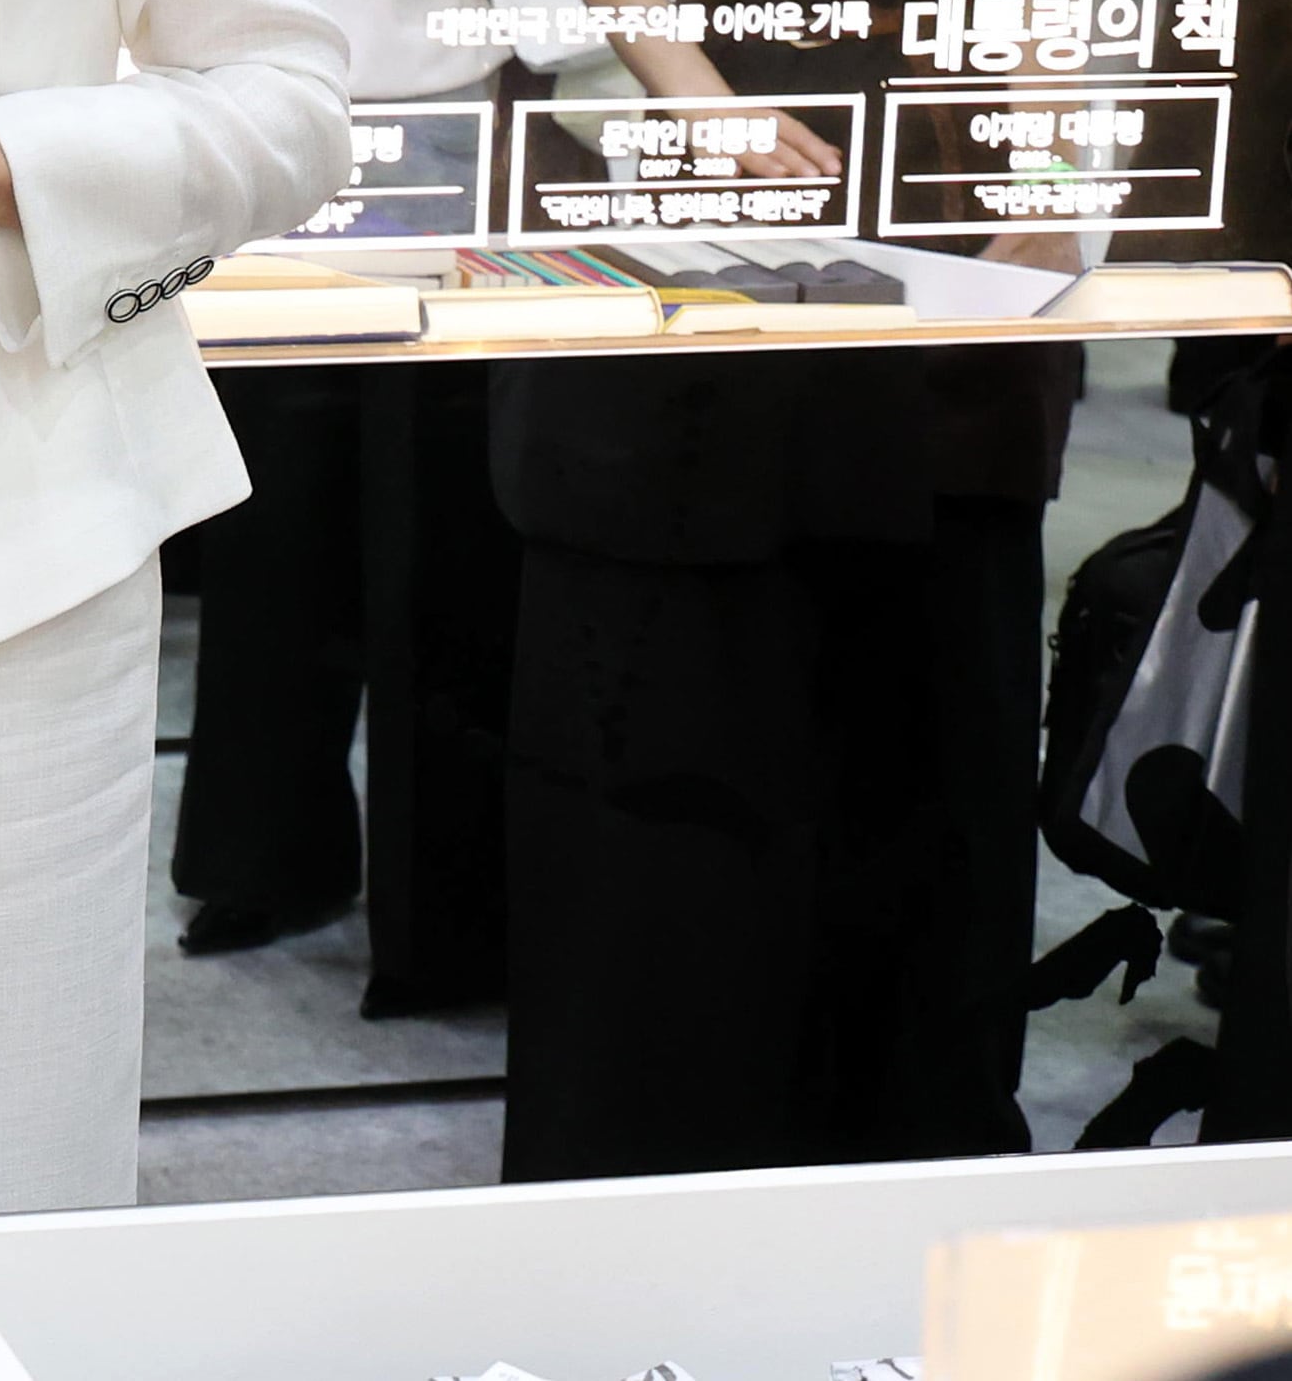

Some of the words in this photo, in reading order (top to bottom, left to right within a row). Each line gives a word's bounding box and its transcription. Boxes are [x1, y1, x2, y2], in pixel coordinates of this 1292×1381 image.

[427, 6, 551, 46] 대한민국
[556, 2, 708, 44] 민주주의를
[809, 0, 872, 40] 기록
[599, 118, 688, 157] 문재인
[692, 117, 778, 154] 대통령
[1060, 108, 1144, 146] 대통령
